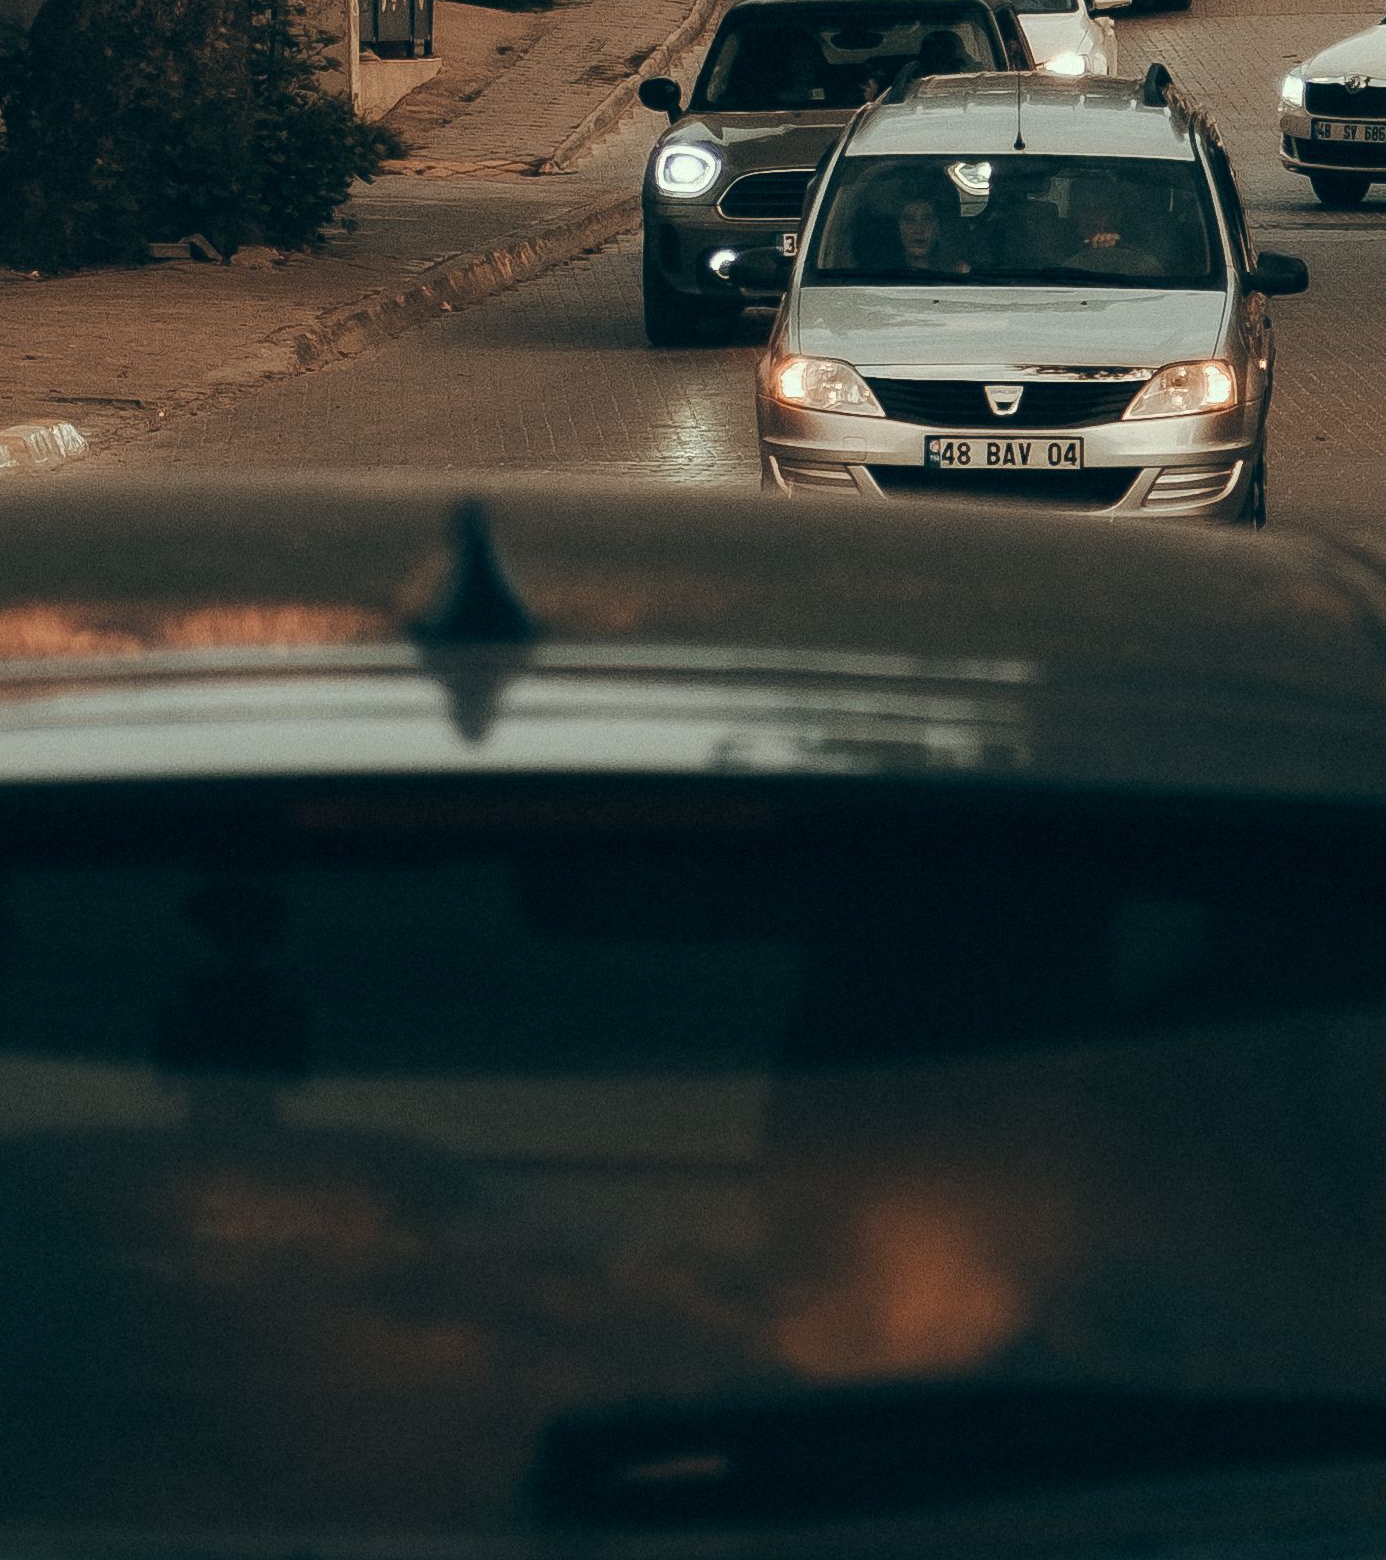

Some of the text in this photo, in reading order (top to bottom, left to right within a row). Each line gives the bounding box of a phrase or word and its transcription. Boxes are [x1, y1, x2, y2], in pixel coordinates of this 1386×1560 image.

[1316, 123, 1332, 139] 48
[941, 441, 1078, 467] 48 BAV 04
